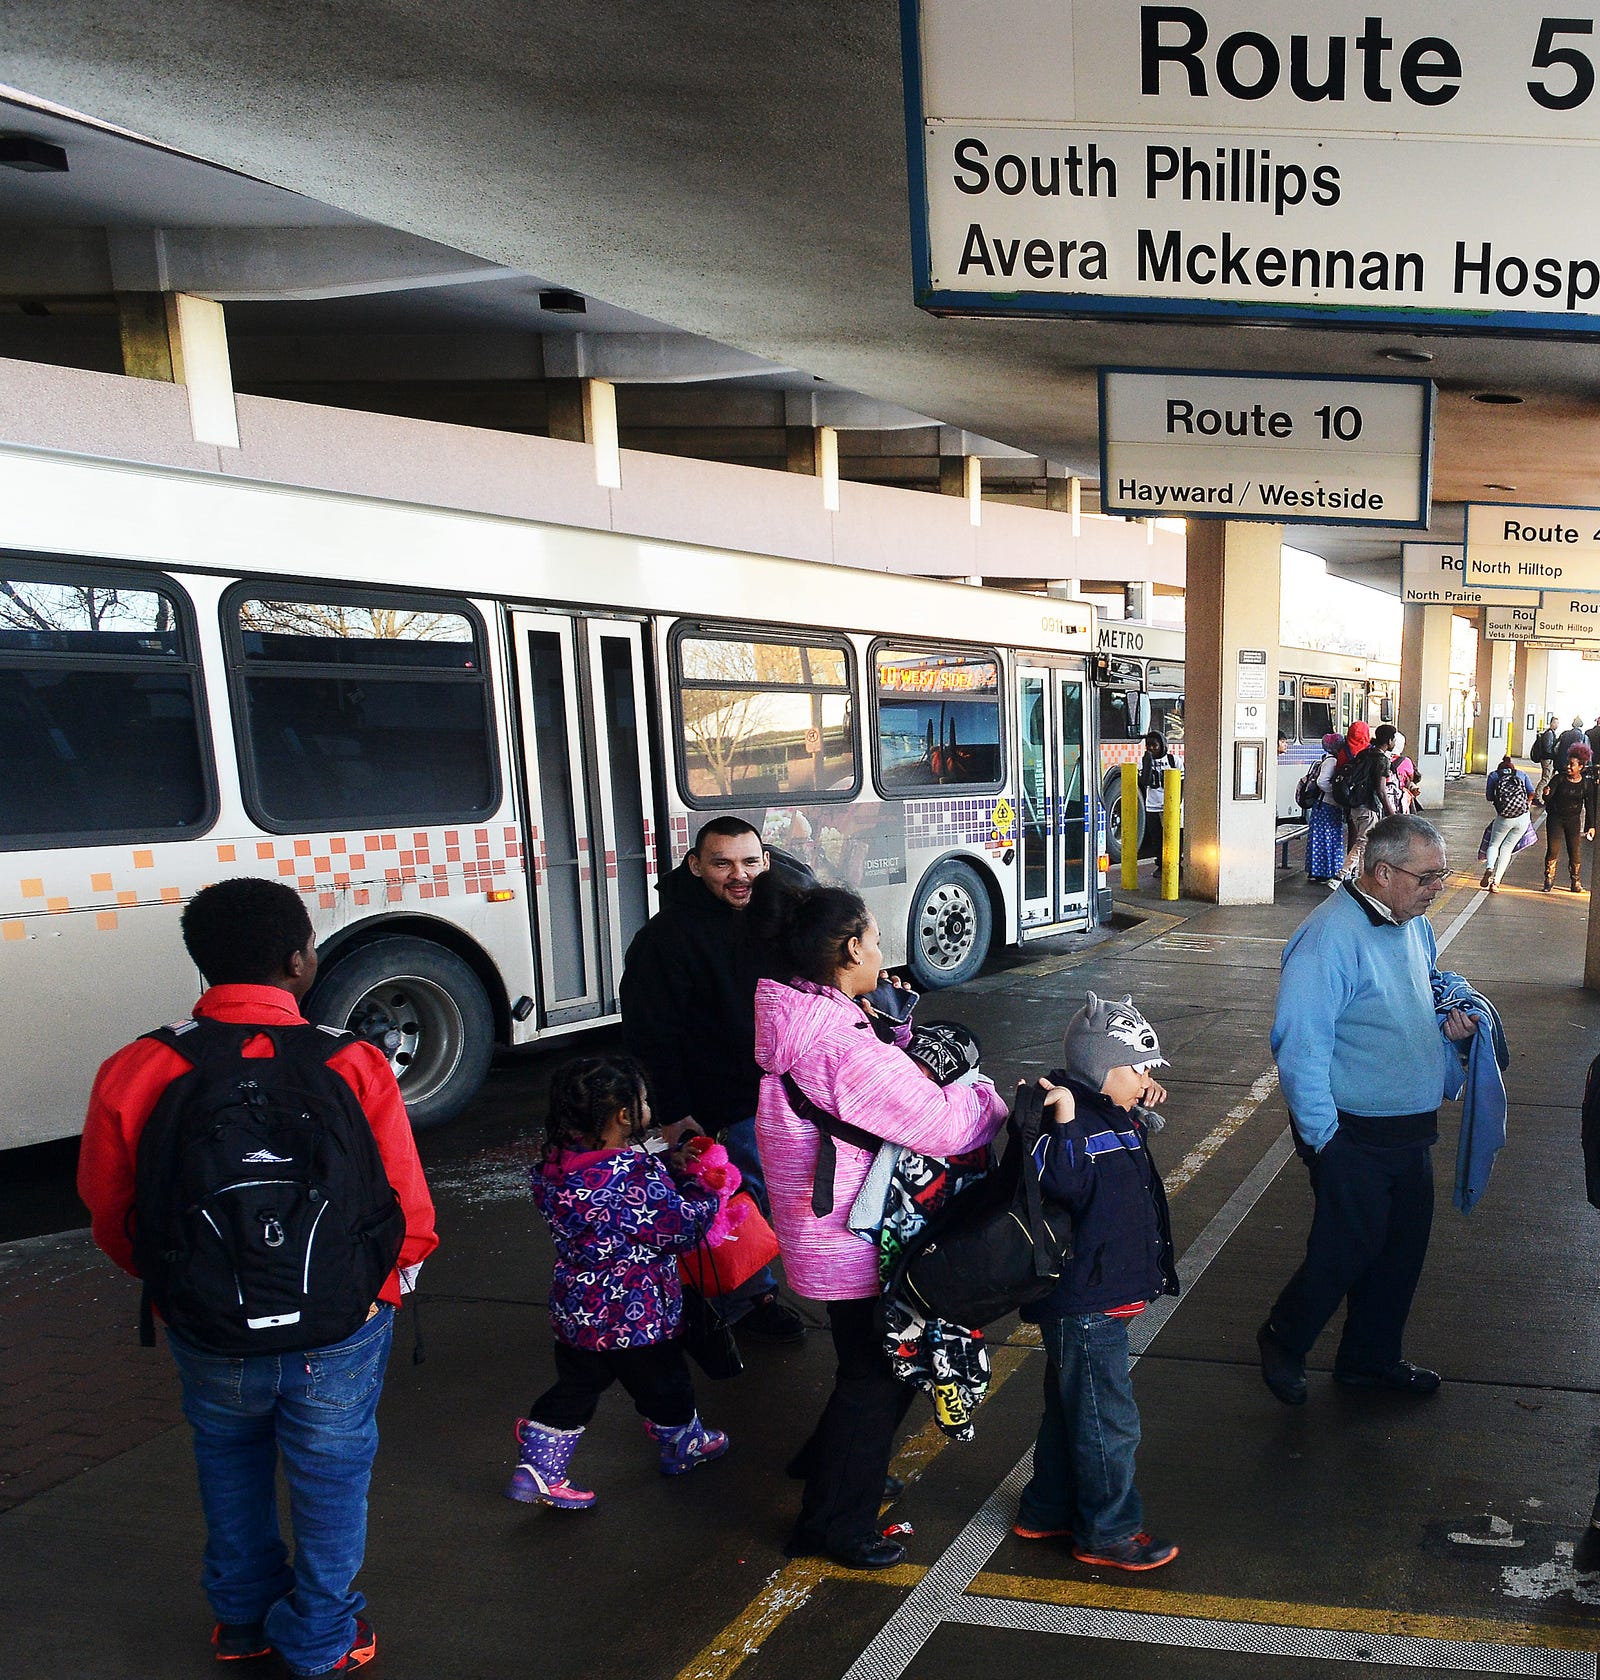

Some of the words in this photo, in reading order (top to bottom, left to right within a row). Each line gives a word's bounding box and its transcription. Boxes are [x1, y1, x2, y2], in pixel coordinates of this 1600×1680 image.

[1140, 5, 1463, 107] Route
[1526, 17, 1597, 112] 5
[952, 138, 1118, 199] South
[1145, 144, 1342, 215] Phillips
[956, 223, 1109, 282] Avera
[1136, 228, 1425, 293] Mckennan
[1165, 399, 1294, 440] Route
[1312, 404, 1363, 442] 10
[1503, 520, 1579, 544] Route
[1471, 559, 1511, 575] North
[1518, 561, 1563, 579] Hilltop
[1406, 589, 1440, 601] North
[1444, 591, 1482, 602] Prairie
[1488, 622, 1512, 630] South
[1539, 621, 1564, 631] South
[1567, 623, 1594, 633] Hilltop
[1097, 628, 1144, 651] METRO
[879, 665, 897, 685] 10
[900, 669, 937, 685] WEST
[1244, 706, 1258, 717] 10
